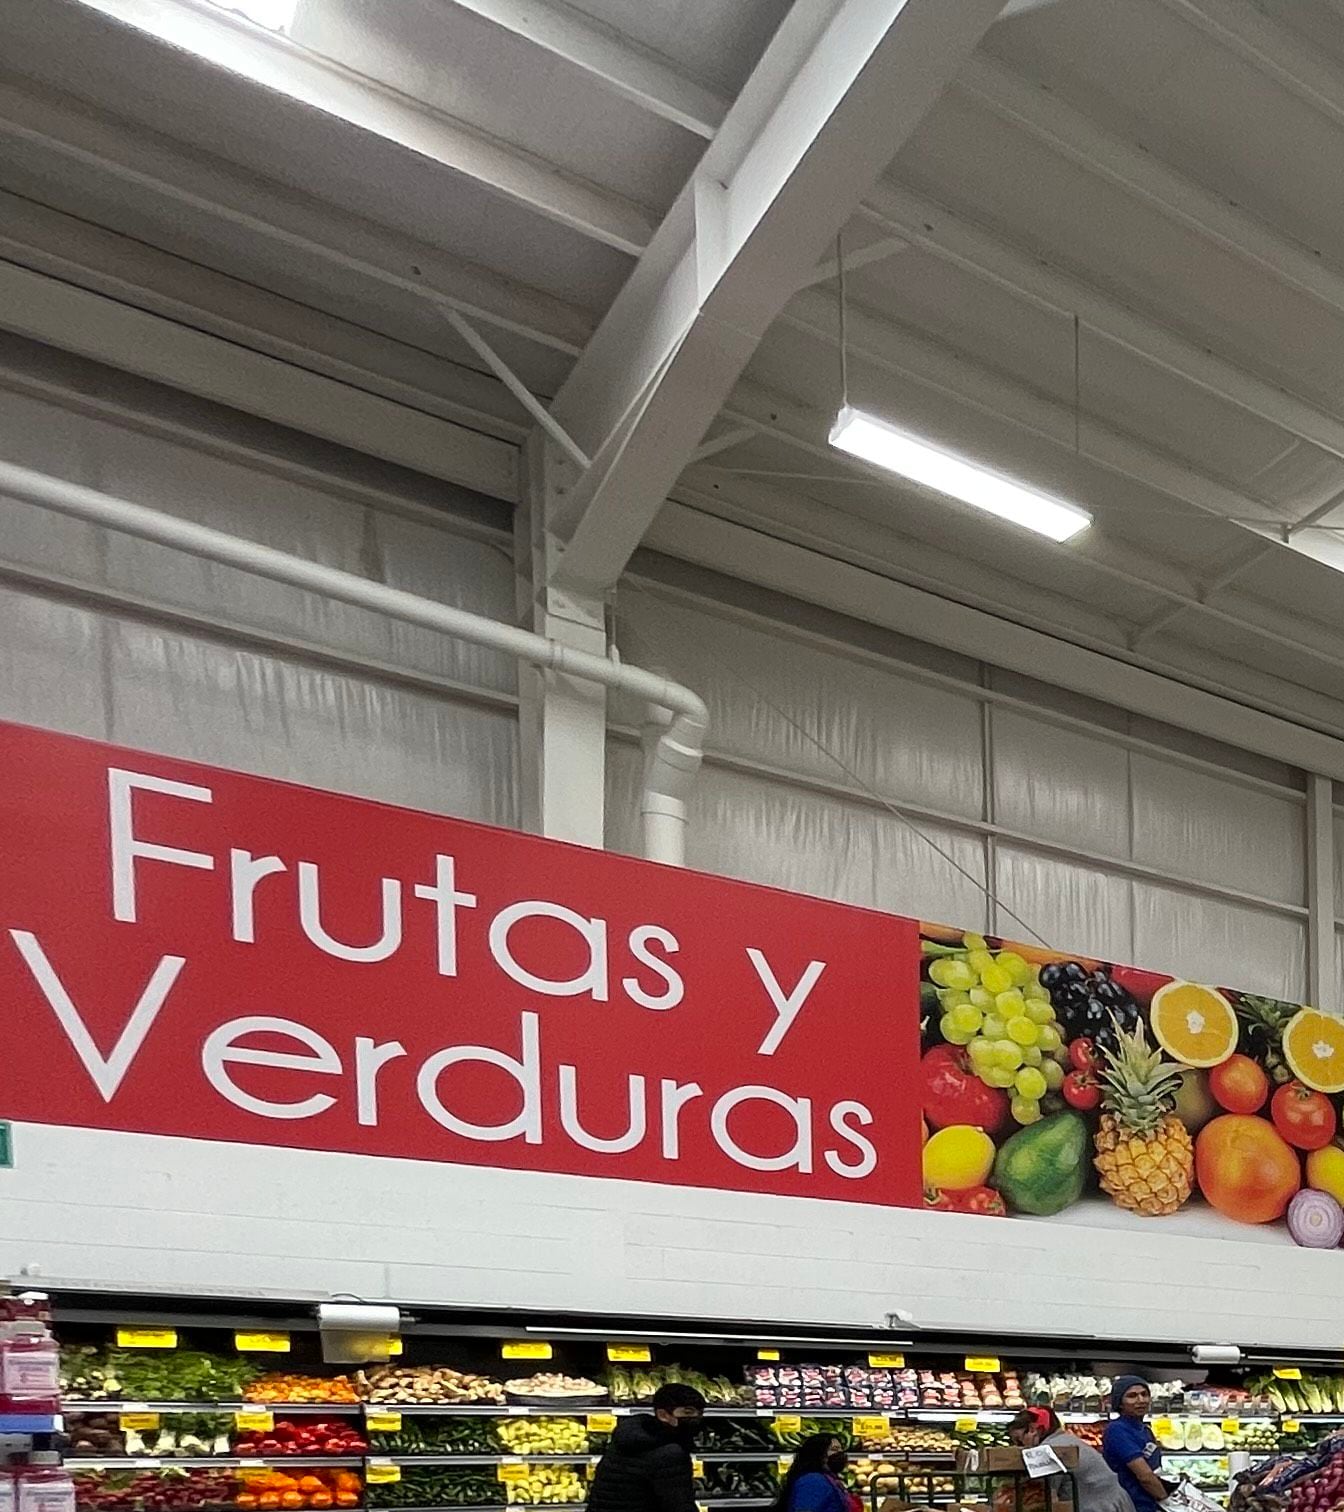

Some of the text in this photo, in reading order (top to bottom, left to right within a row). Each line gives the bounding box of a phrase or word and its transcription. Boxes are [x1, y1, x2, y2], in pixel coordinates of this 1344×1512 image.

[107, 767, 826, 1056] Frutas y
[9, 929, 878, 1180] Verduras
